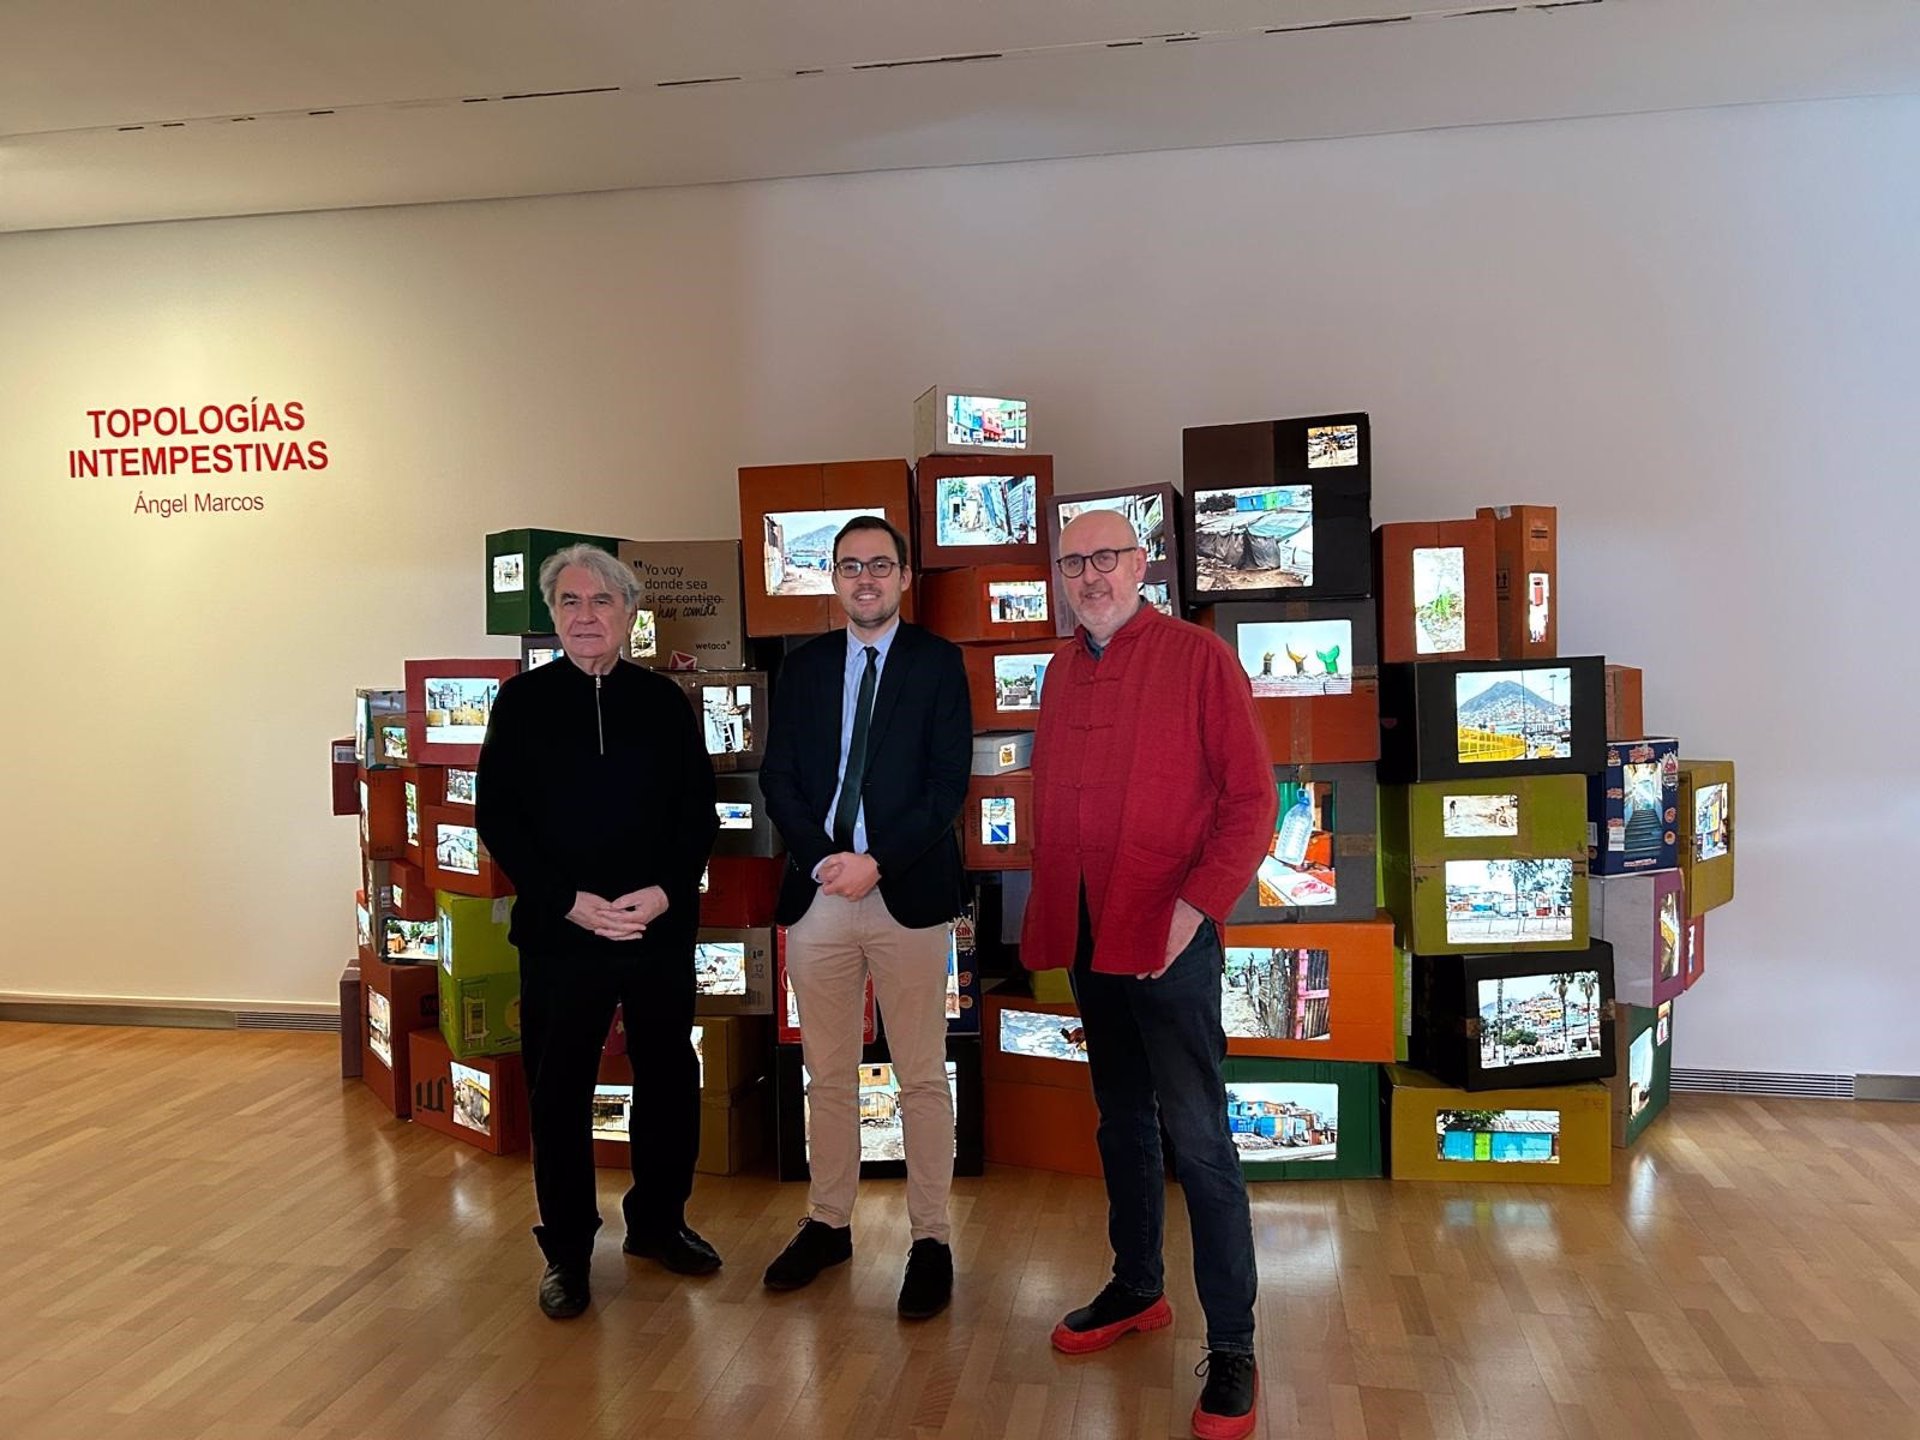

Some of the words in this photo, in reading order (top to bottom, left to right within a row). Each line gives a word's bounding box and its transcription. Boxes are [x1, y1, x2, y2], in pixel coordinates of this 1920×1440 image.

[86, 396, 305, 438] TOPOLOGÍAS
[69, 440, 329, 478] INTEMPESTIVAS
[134, 490, 188, 518] Ángel
[194, 493, 265, 512] Marcos
[661, 566, 684, 577] voy
[644, 579, 683, 590] donde
[686, 581, 708, 590] sea
[645, 593, 655, 604] si
